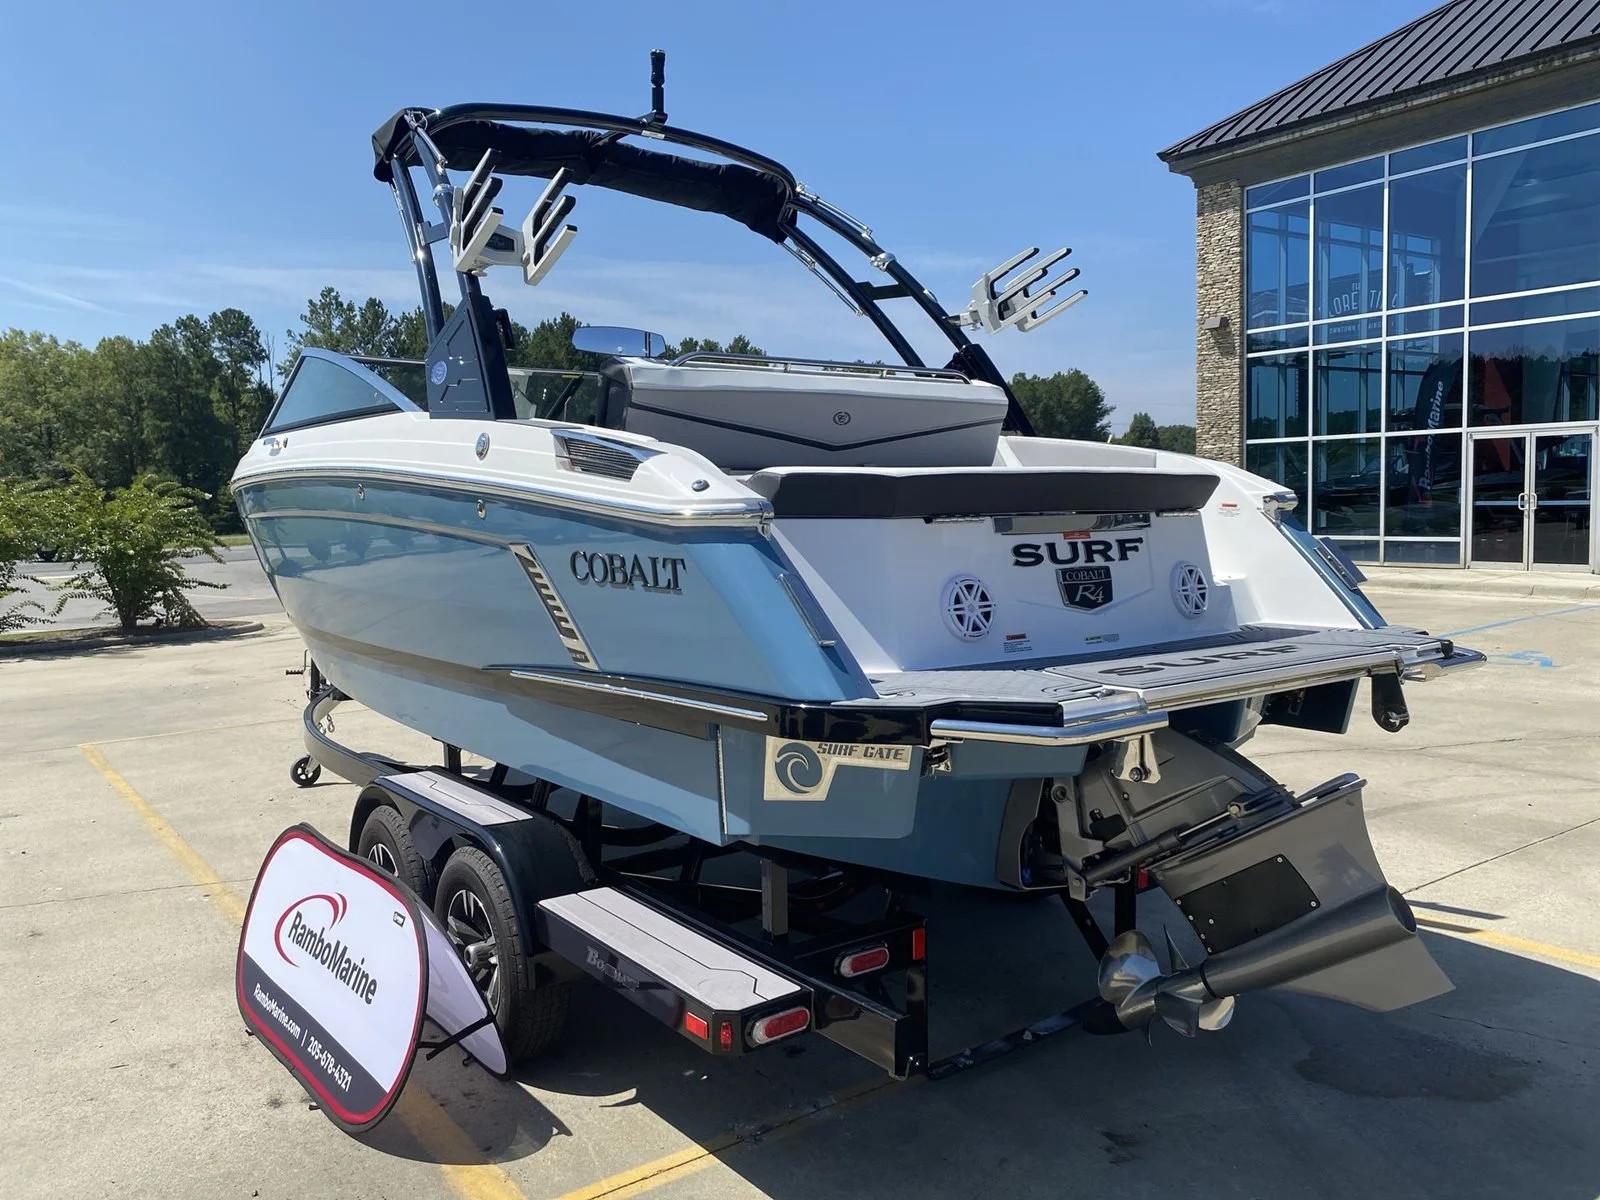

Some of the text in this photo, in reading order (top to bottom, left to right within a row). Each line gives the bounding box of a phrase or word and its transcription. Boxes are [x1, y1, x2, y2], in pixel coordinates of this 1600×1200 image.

[1012, 536, 1144, 567] SURF
[570, 550, 688, 592] COBALT
[1065, 569, 1106, 581] COBALT
[1098, 644, 1299, 677] SURF
[816, 742, 905, 760] SURF GATE
[287, 910, 378, 1005] RamboMarine
[253, 982, 353, 1093] RamboMarine.com 205-678-4321
